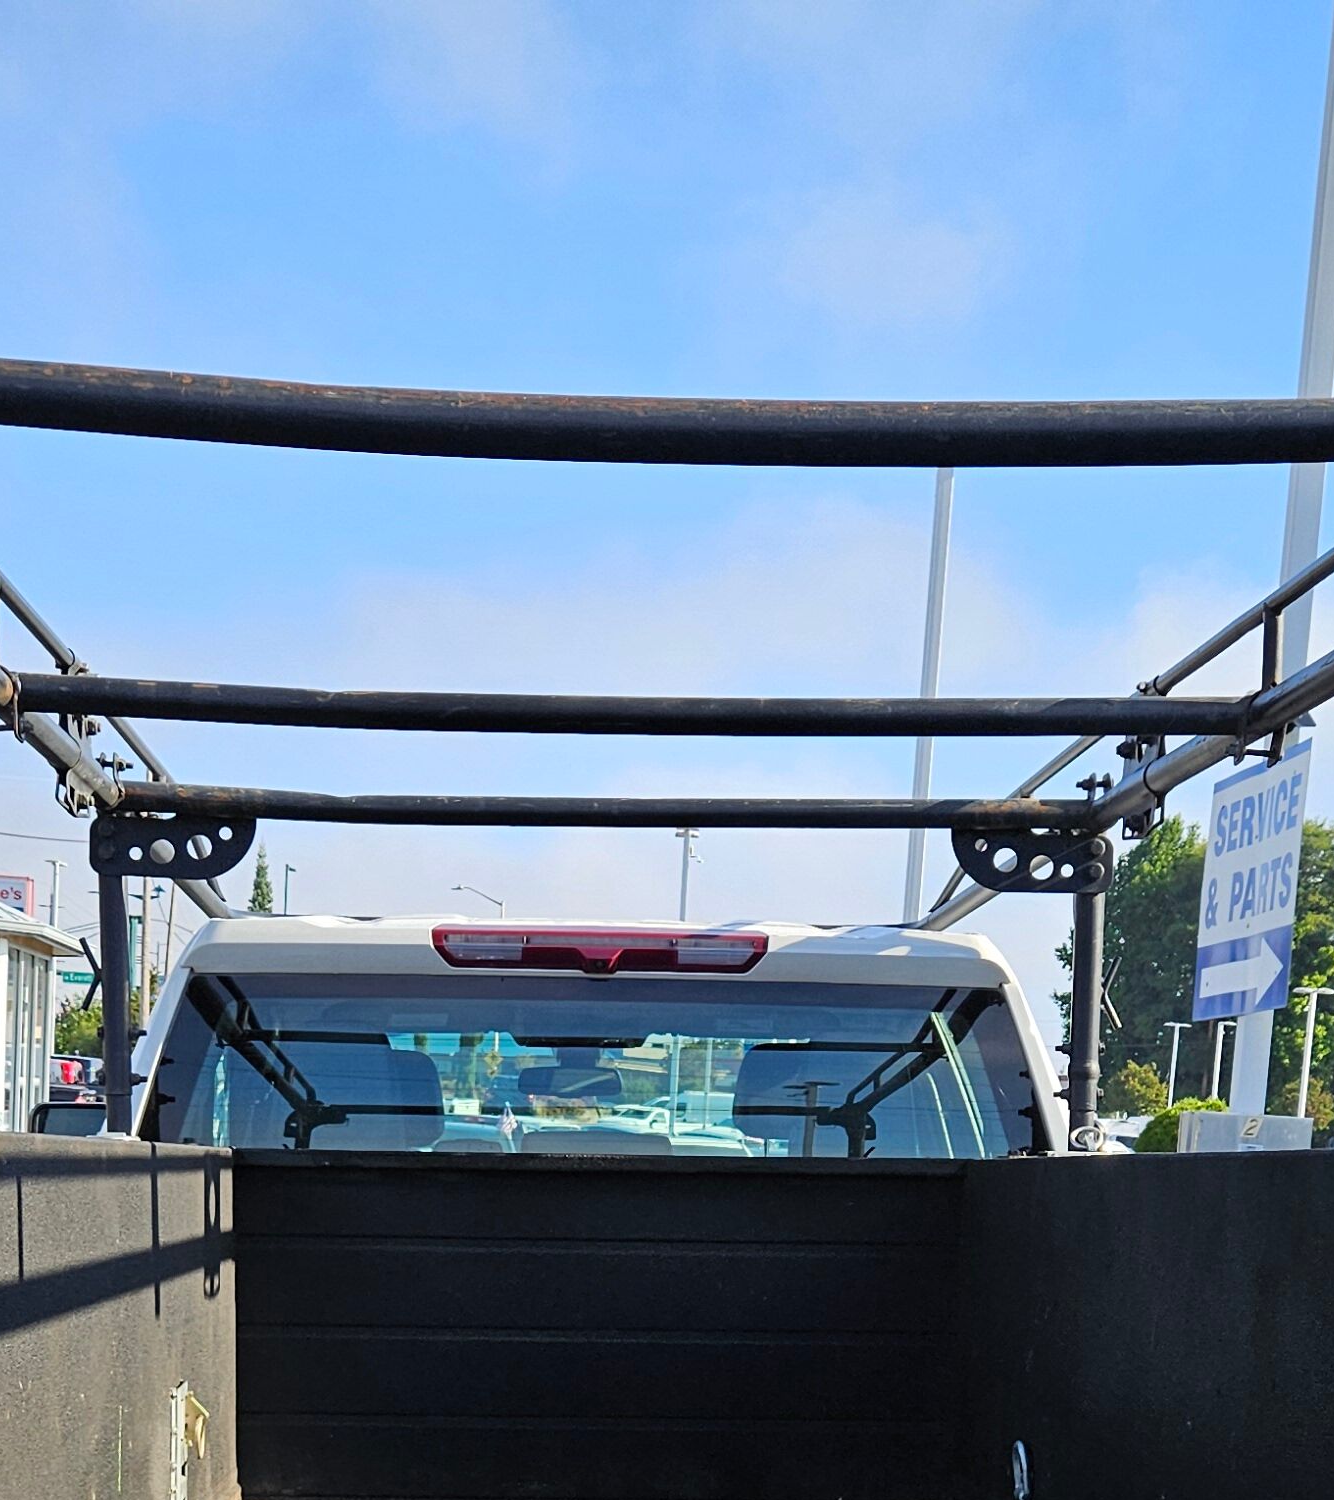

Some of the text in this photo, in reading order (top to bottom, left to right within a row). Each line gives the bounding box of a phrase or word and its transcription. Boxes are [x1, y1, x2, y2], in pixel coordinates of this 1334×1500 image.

[1214, 770, 1303, 857] SERVICE
[1205, 852, 1293, 930] & PARTS
[1243, 1118, 1258, 1136] 2
